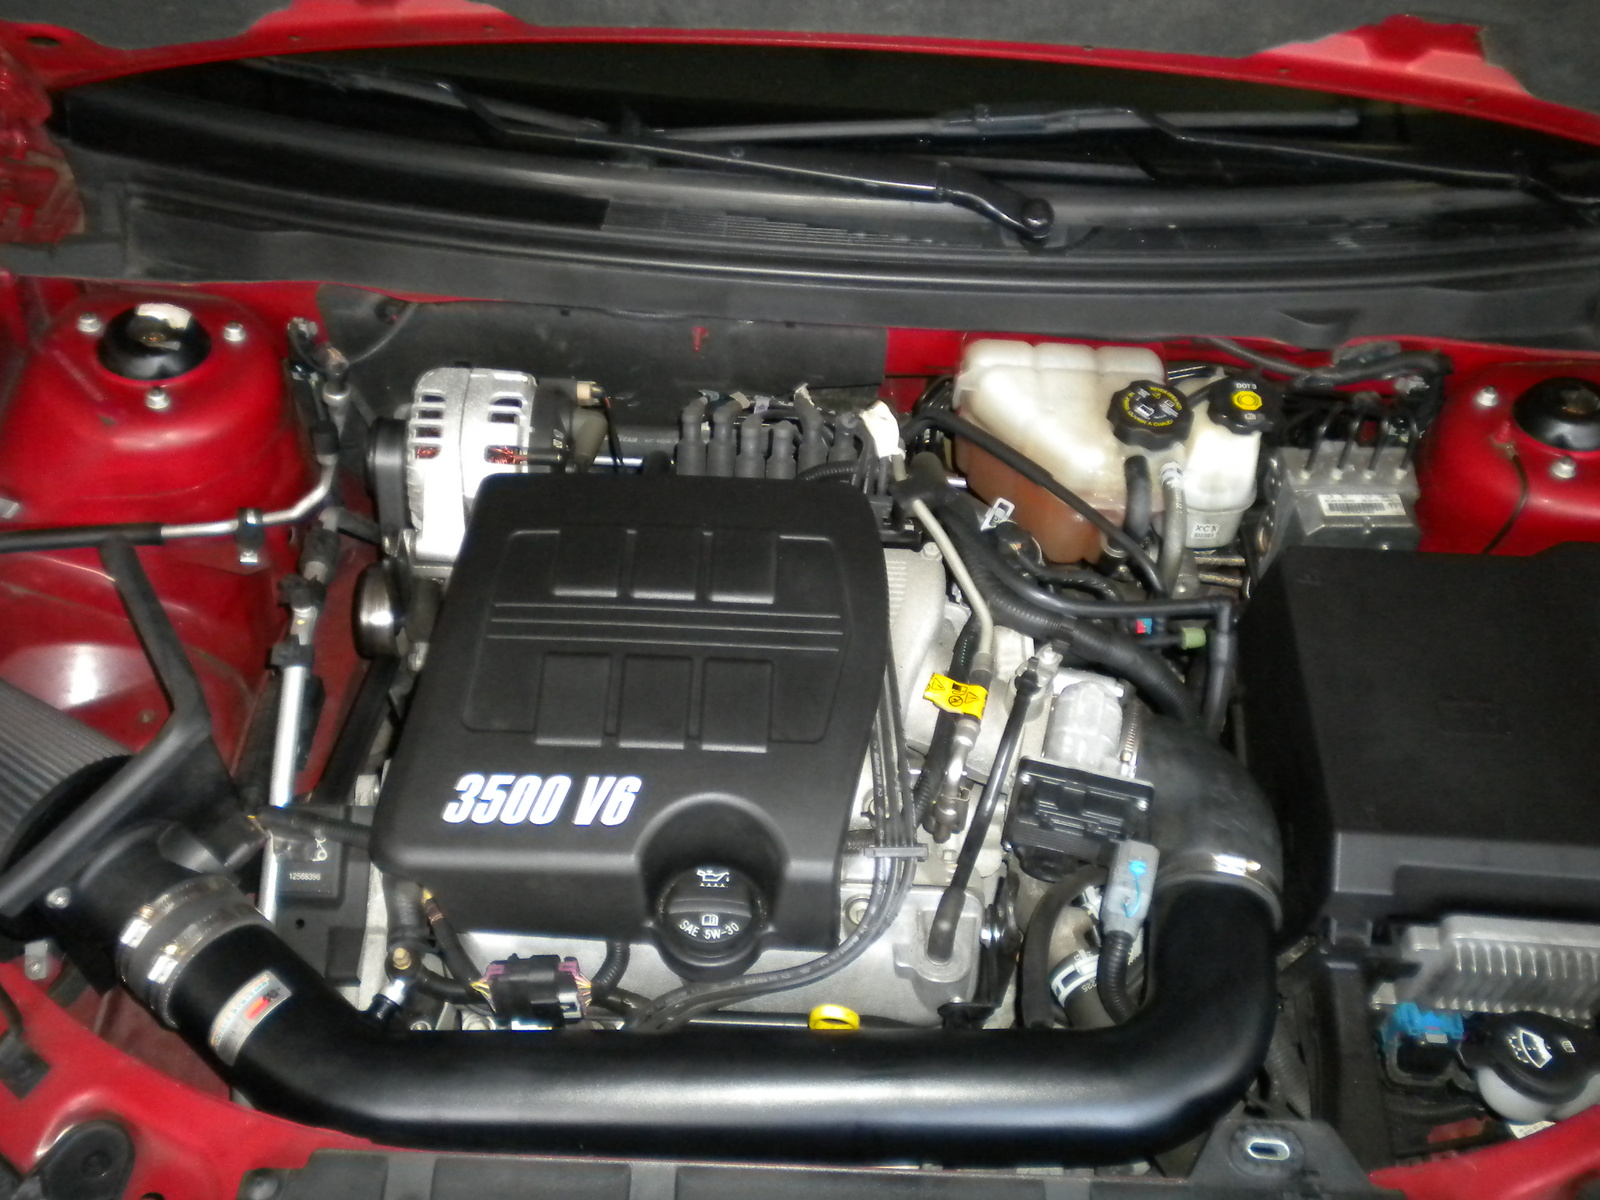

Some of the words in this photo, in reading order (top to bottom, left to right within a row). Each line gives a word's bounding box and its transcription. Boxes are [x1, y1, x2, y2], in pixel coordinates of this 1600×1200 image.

[443, 772, 572, 825] 3500
[571, 775, 642, 826] V6
[679, 920, 700, 937] SAE
[704, 922, 739, 940] 5W-30
